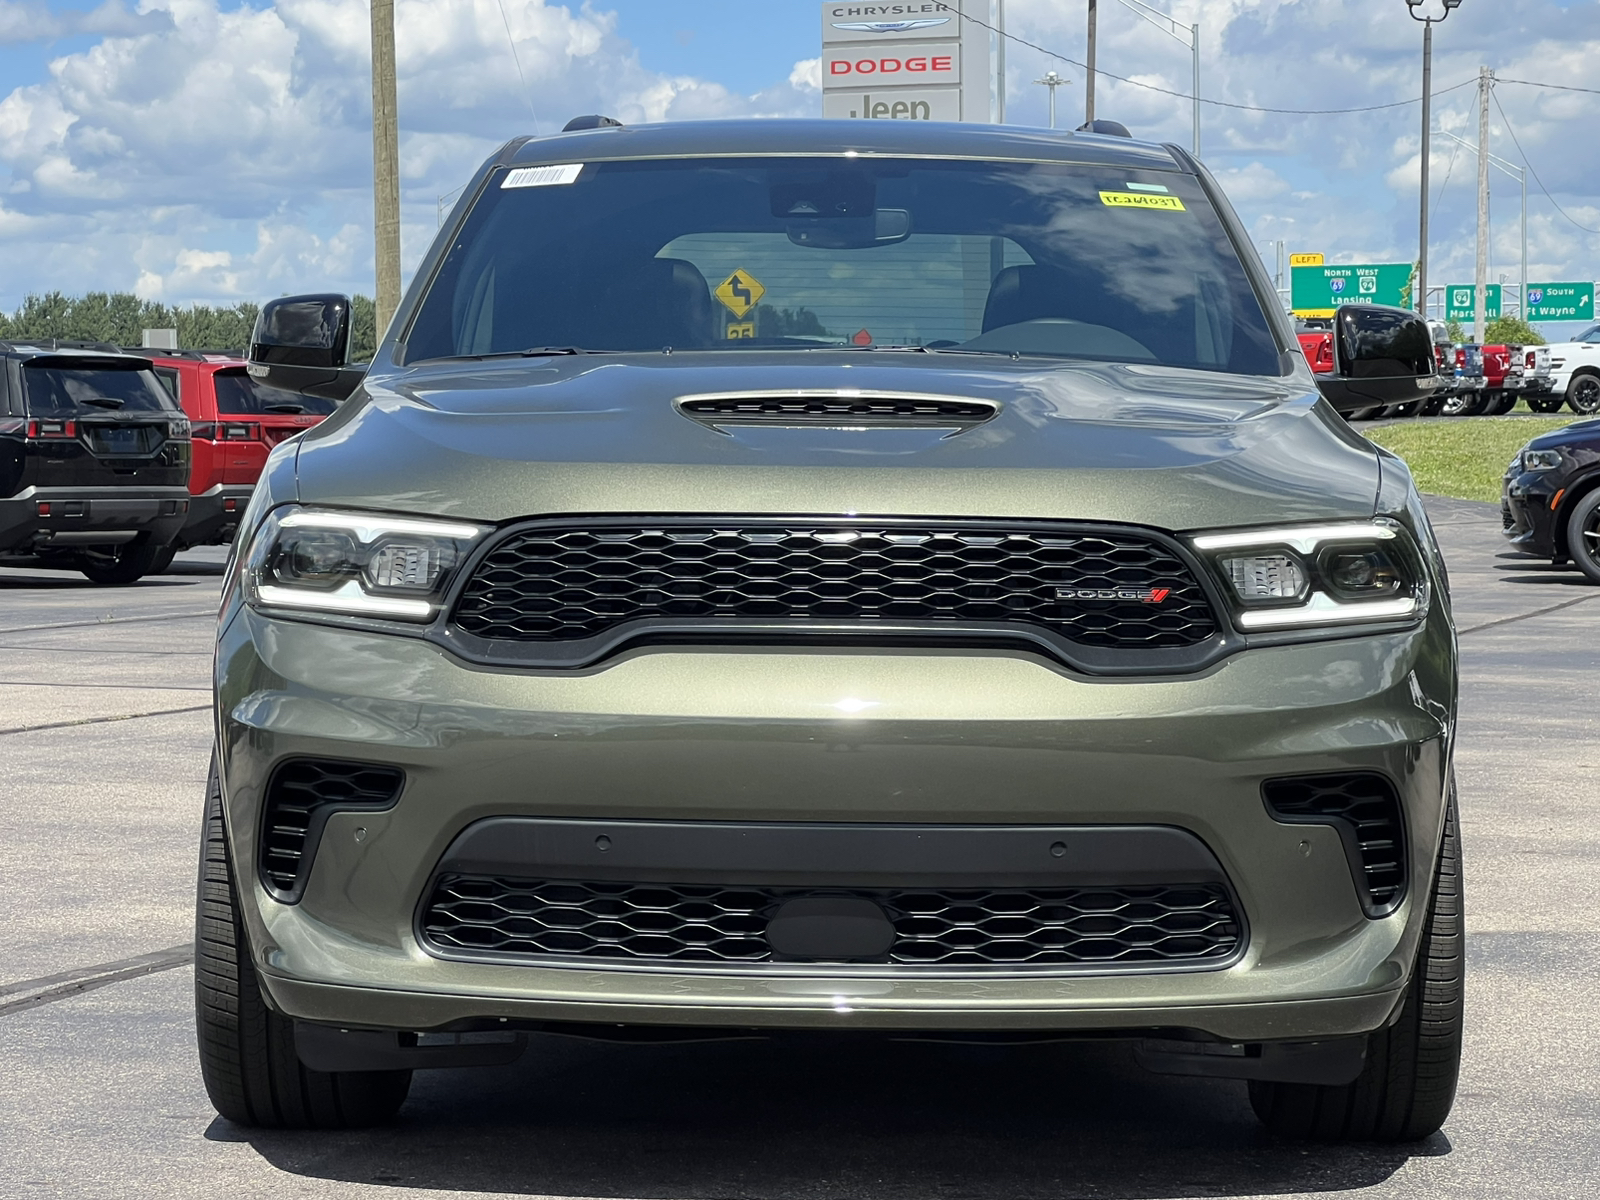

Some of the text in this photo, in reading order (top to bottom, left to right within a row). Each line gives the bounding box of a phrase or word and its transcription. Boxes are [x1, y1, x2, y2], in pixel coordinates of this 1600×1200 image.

[832, 4, 949, 17] CHRYSLER
[830, 56, 952, 75] DODGE
[1295, 256, 1317, 264] LEFT
[1324, 268, 1379, 277] NORTH WEST
[1332, 281, 1373, 290] 69 94
[1546, 288, 1575, 296] SOUTH
[1456, 294, 1467, 303] 94
[1530, 293, 1541, 301] 69
[1539, 307, 1576, 317] Wayne
[1056, 589, 1155, 599] DODGE
